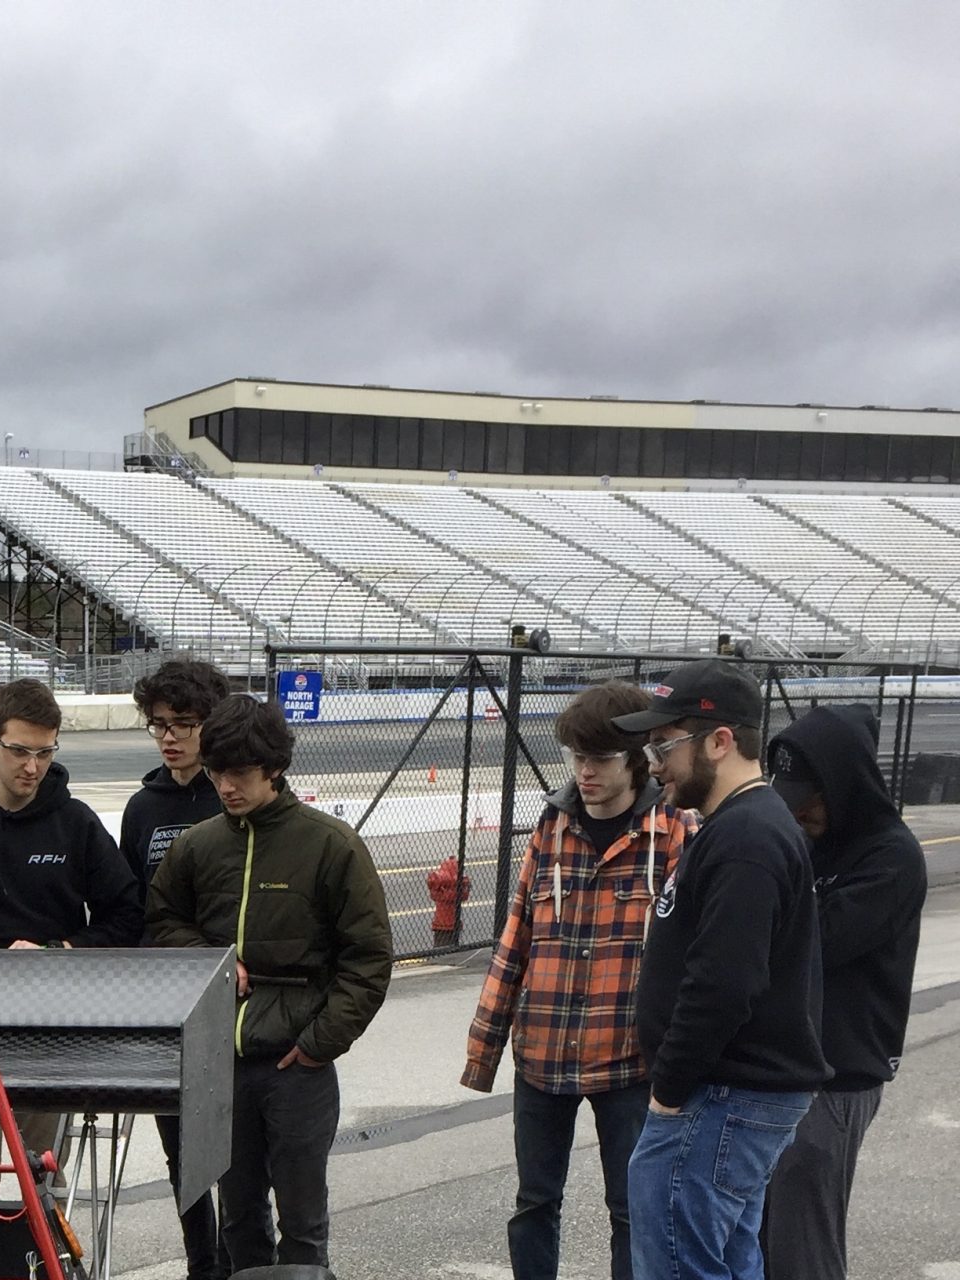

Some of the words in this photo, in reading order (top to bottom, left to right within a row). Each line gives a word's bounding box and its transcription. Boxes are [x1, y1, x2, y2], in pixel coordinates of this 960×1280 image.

[287, 691, 313, 701] NORTH
[284, 701, 314, 711] GARAGE
[292, 710, 305, 721] PIT
[27, 854, 67, 864] RFH
